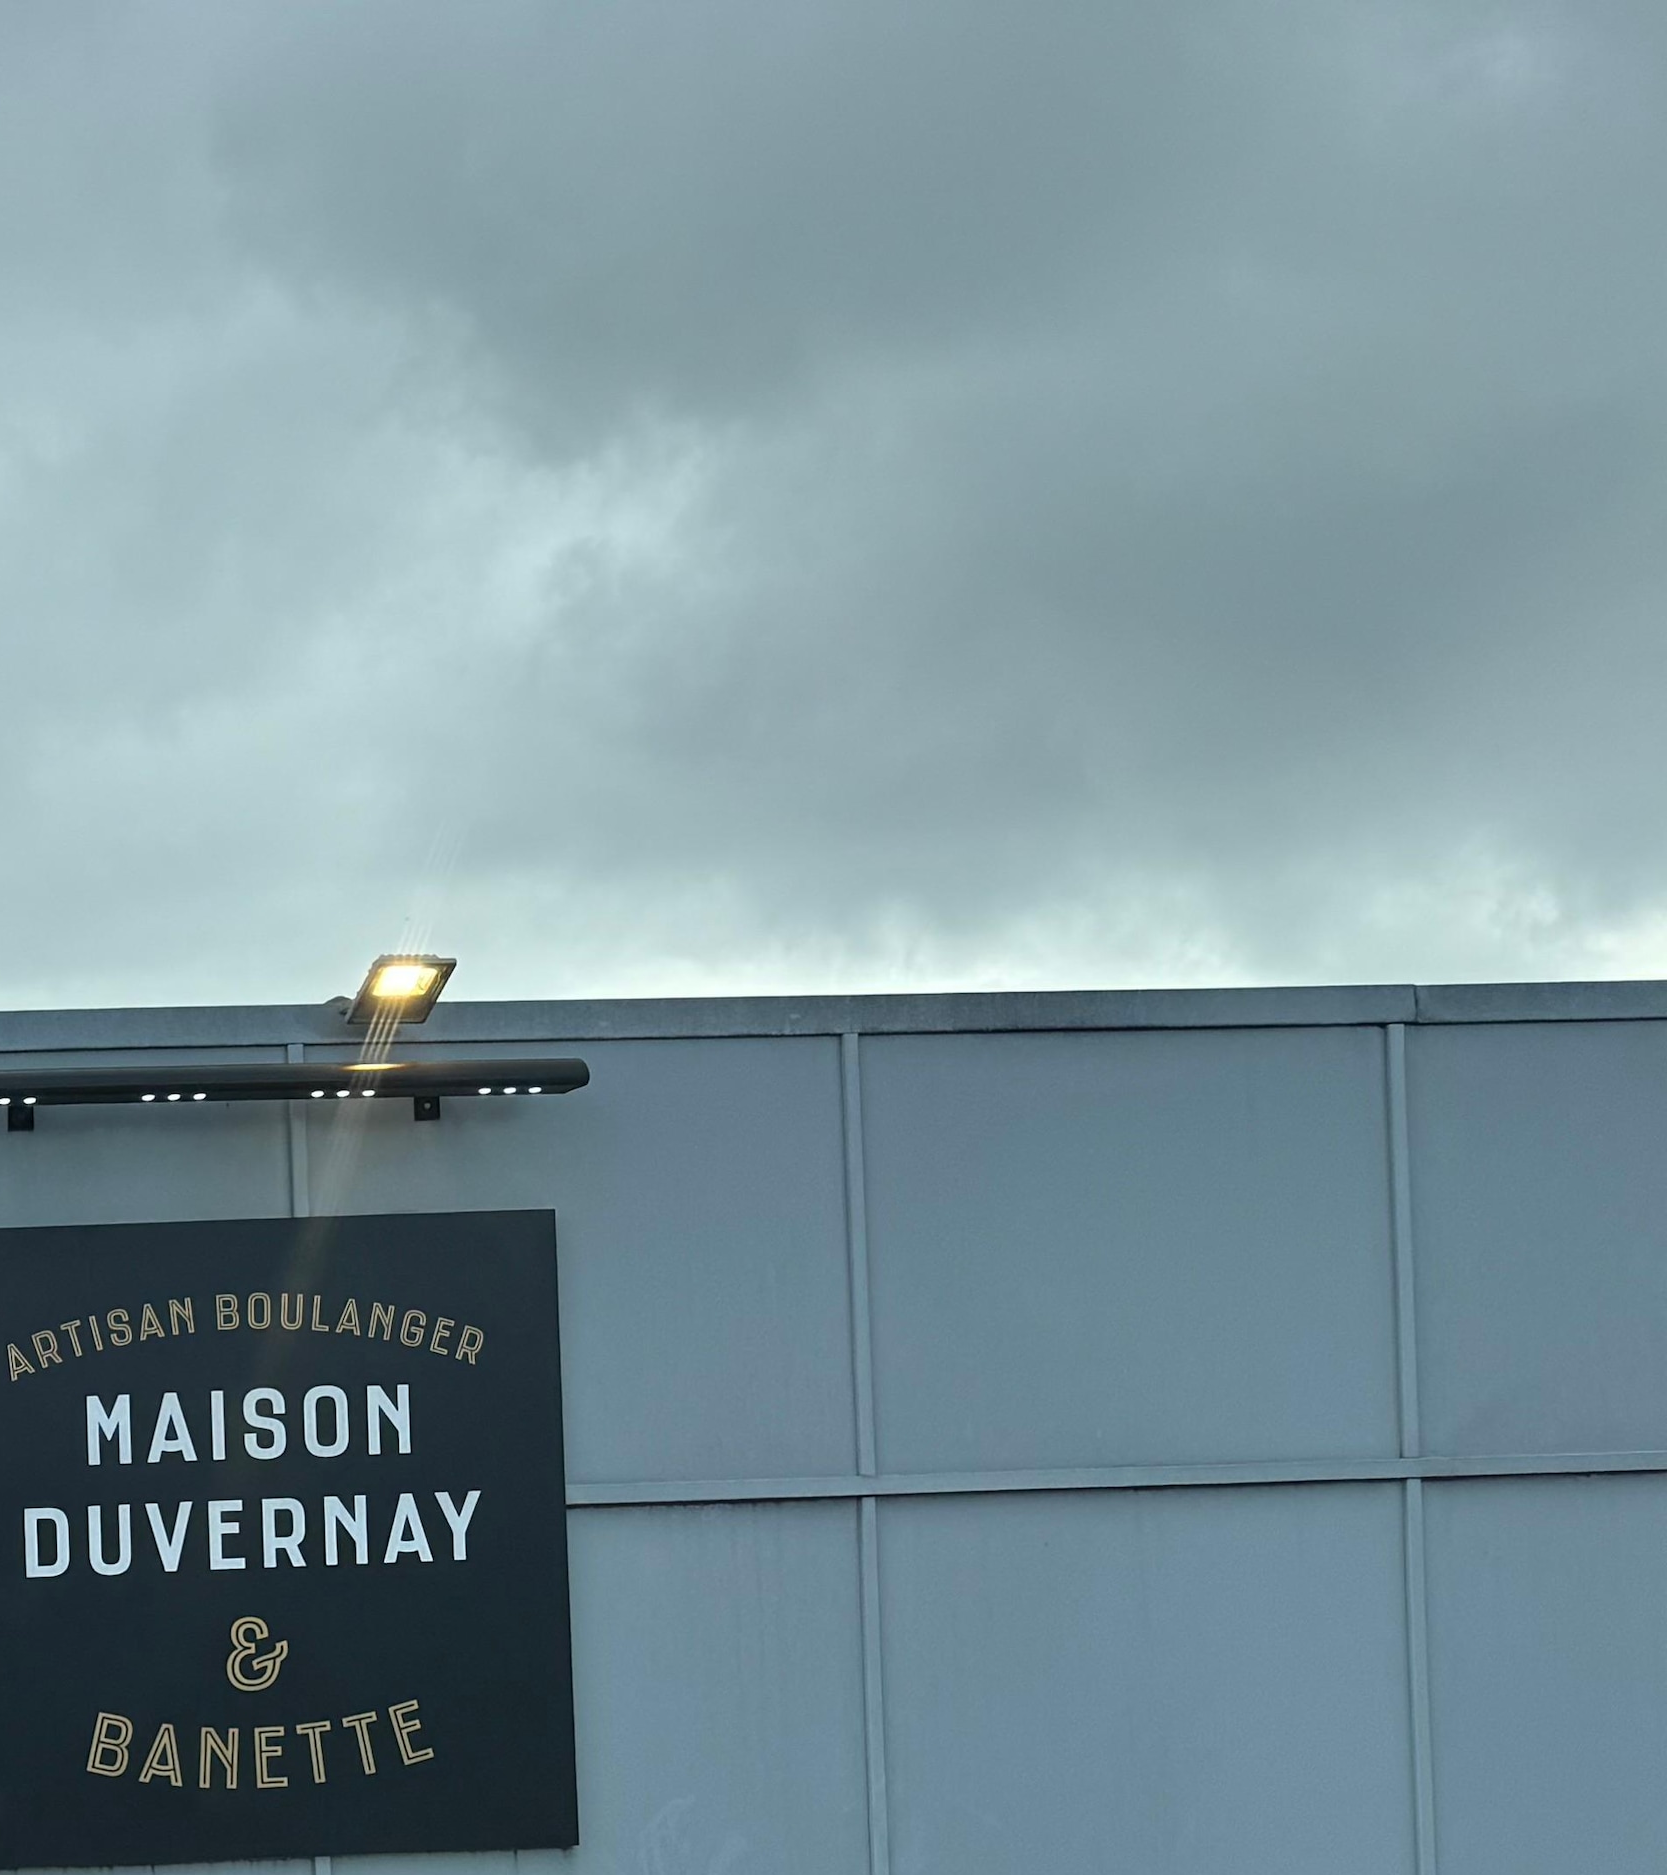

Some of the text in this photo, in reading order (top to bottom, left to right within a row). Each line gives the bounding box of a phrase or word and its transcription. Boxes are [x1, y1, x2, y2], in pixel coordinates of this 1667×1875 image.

[7, 1292, 485, 1382] ARTISAN BOULANGER
[85, 1384, 413, 1466] MAISON
[23, 1490, 481, 1578] DUVERNAY
[226, 1616, 289, 1691] &
[86, 1699, 435, 1789] BANETTE
